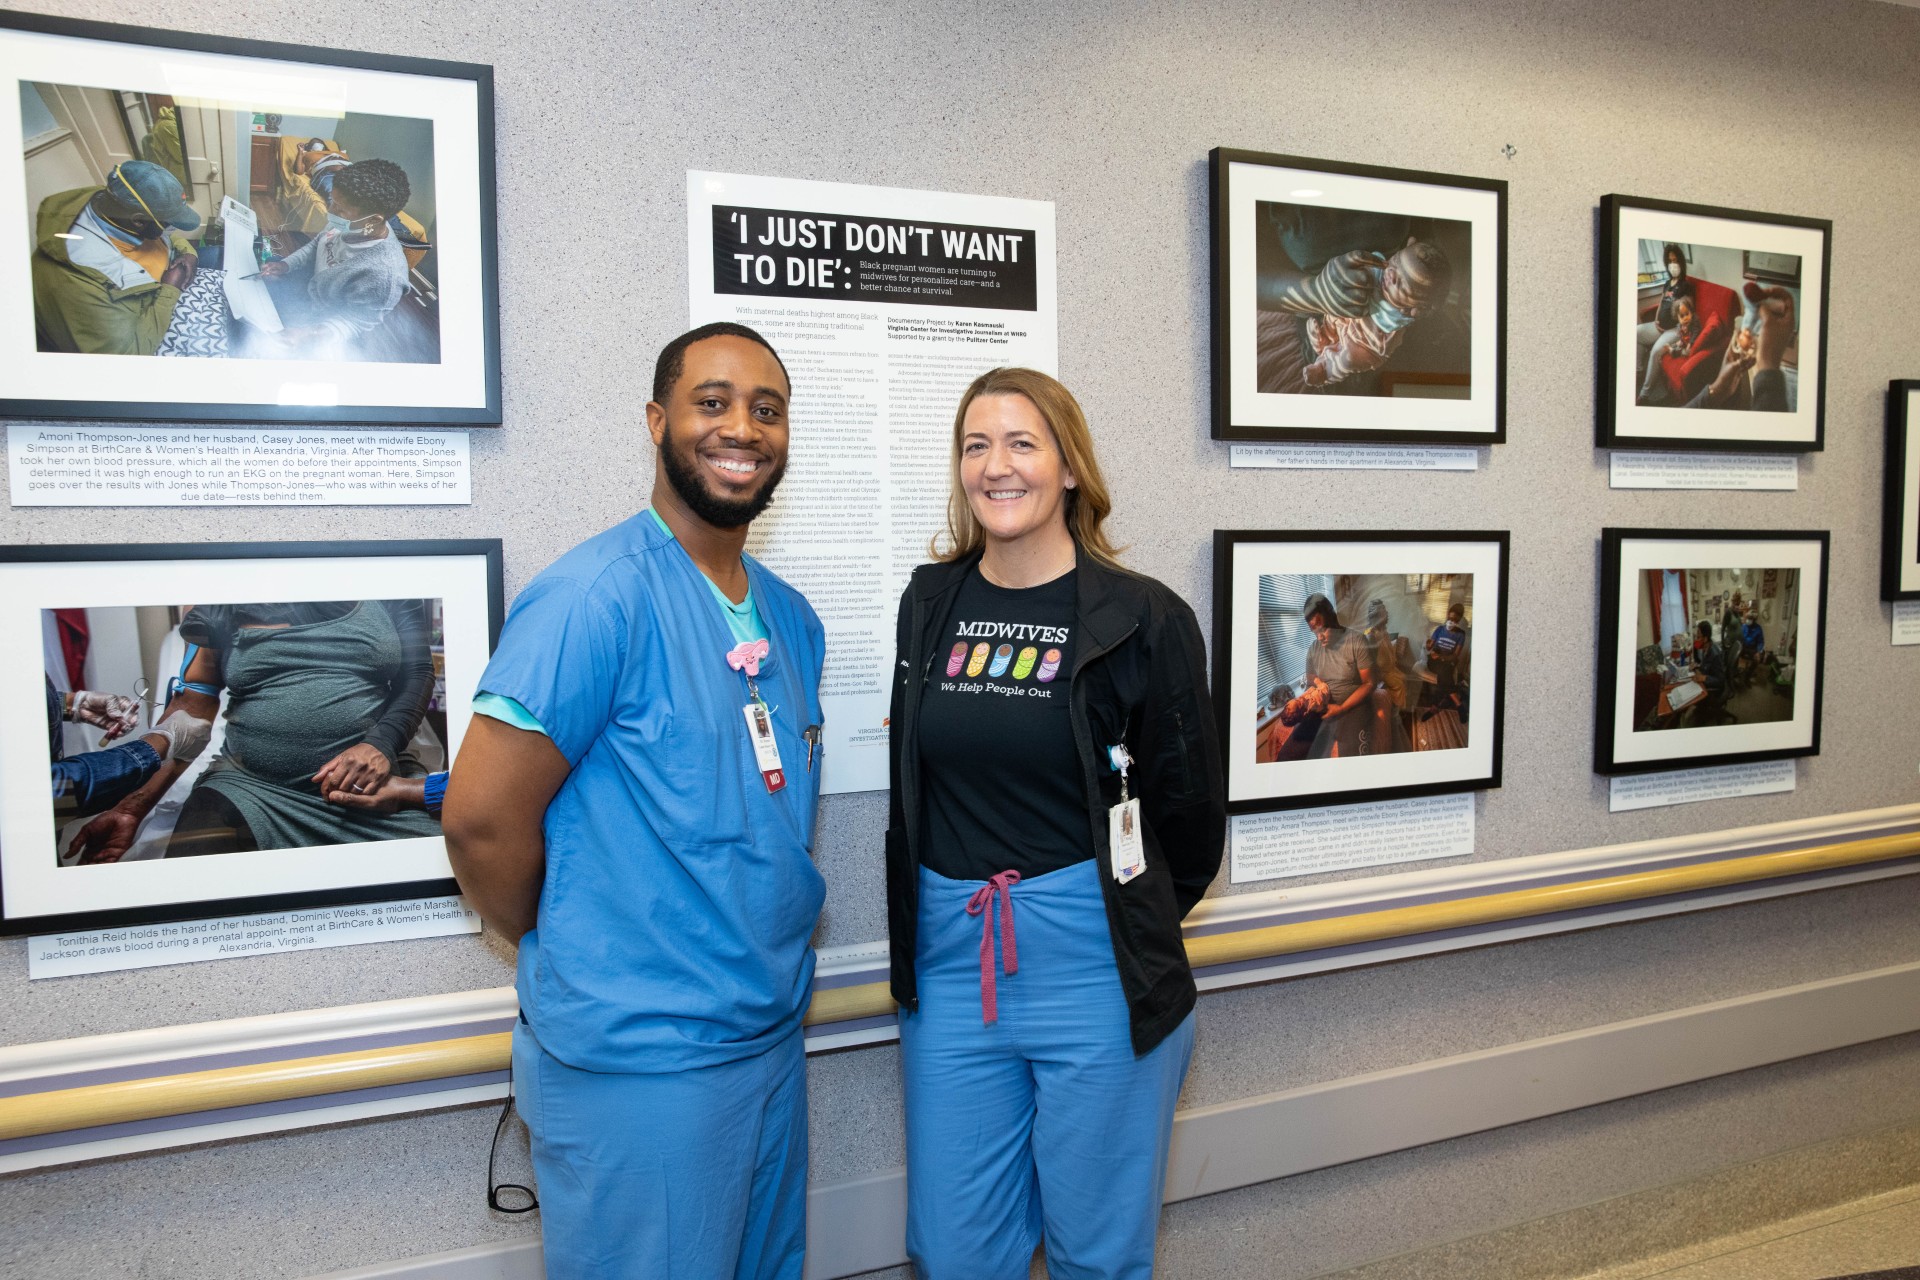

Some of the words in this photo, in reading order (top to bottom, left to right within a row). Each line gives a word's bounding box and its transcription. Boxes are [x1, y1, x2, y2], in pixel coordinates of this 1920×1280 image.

[730, 212, 748, 244] 'I
[758, 216, 836, 250] JUST
[846, 222, 934, 256] DON'T
[942, 231, 1022, 262] WANT
[734, 254, 776, 284] TO
[786, 258, 852, 290] DIE':
[859, 260, 880, 269] Black
[882, 264, 916, 272] pregnant
[960, 267, 987, 278] turning
[860, 271, 897, 280] midwives
[898, 273, 908, 281] for
[911, 275, 957, 284] personalized
[860, 281, 881, 290] better
[884, 283, 911, 292] chance
[922, 286, 953, 295] survival.
[38, 431, 72, 440] Amoni
[76, 432, 167, 442] Thompson-Jones
[171, 434, 190, 442] and
[193, 434, 208, 442] her
[212, 434, 258, 443] husband,
[262, 434, 292, 445] Casey
[296, 435, 327, 444] Jones,
[357, 435, 375, 444] with
[378, 436, 413, 444] midwife
[416, 436, 445, 446] Ebony
[26, 444, 74, 454] Simpson
[91, 444, 141, 453] BirthCare
[145, 445, 152, 453] &
[156, 445, 203, 453] Women's
[206, 445, 238, 454] Health
[242, 446, 250, 454] in
[254, 446, 307, 455] Alexandria,
[311, 446, 349, 456] Virginia.
[352, 446, 372, 455] After
[377, 447, 455, 457] Thompson-Jones
[20, 456, 42, 464] took
[47, 456, 64, 464] her
[94, 456, 122, 464] blood
[178, 457, 207, 465] which
[210, 457, 221, 465] all
[225, 457, 240, 465] the
[282, 457, 294, 466] do
[297, 458, 327, 466] before
[330, 458, 350, 466] their
[354, 458, 419, 468] appointments,
[422, 458, 461, 468] Simpson
[30, 468, 90, 476] determined
[94, 468, 100, 476] it
[128, 468, 150, 478] high
[153, 468, 192, 478] enough
[243, 469, 266, 477] EKG
[284, 469, 299, 477] the
[302, 469, 344, 479] pregnant
[387, 469, 412, 478] Here,
[415, 469, 454, 479] Simpson
[86, 480, 102, 488] the
[106, 480, 140, 488] results
[144, 480, 164, 488] with
[168, 480, 198, 488] Jones
[202, 480, 227, 488] while
[369, 480, 396, 488] within
[399, 480, 428, 488] weeks
[431, 480, 439, 488] of
[442, 480, 456, 488] her
[181, 492, 199, 500] due
[263, 491, 296, 499] behind
[299, 491, 325, 499] them.
[956, 621, 1069, 644] MIDWIVES
[941, 682, 956, 692] We
[957, 682, 983, 694] Help
[986, 682, 1025, 697] People
[1028, 688, 1052, 698] Out
[57, 934, 98, 946] Tonithia
[102, 931, 126, 942] Reid
[130, 928, 158, 939] holds
[162, 926, 177, 935] the
[181, 922, 206, 933] hand
[210, 921, 220, 930] of
[222, 920, 238, 929] her
[242, 915, 287, 927] husband,
[291, 911, 330, 922] Dominic
[333, 908, 368, 918] Weeks,
[385, 902, 421, 913] midwife
[424, 898, 458, 909] Marsha
[39, 949, 84, 960] Jackson
[88, 946, 120, 955] draws
[124, 940, 153, 951] blood
[156, 937, 189, 947] during
[202, 930, 242, 945] prenatal
[246, 927, 285, 939] appoint-
[289, 924, 313, 934] ment
[316, 922, 325, 931] at
[328, 919, 373, 930] BirthCare
[376, 916, 383, 925] &
[386, 912, 429, 924] Women's
[432, 908, 462, 919] Health
[464, 908, 473, 916] in
[219, 939, 273, 952] Alexandria,
[278, 935, 317, 947] Virginia.
